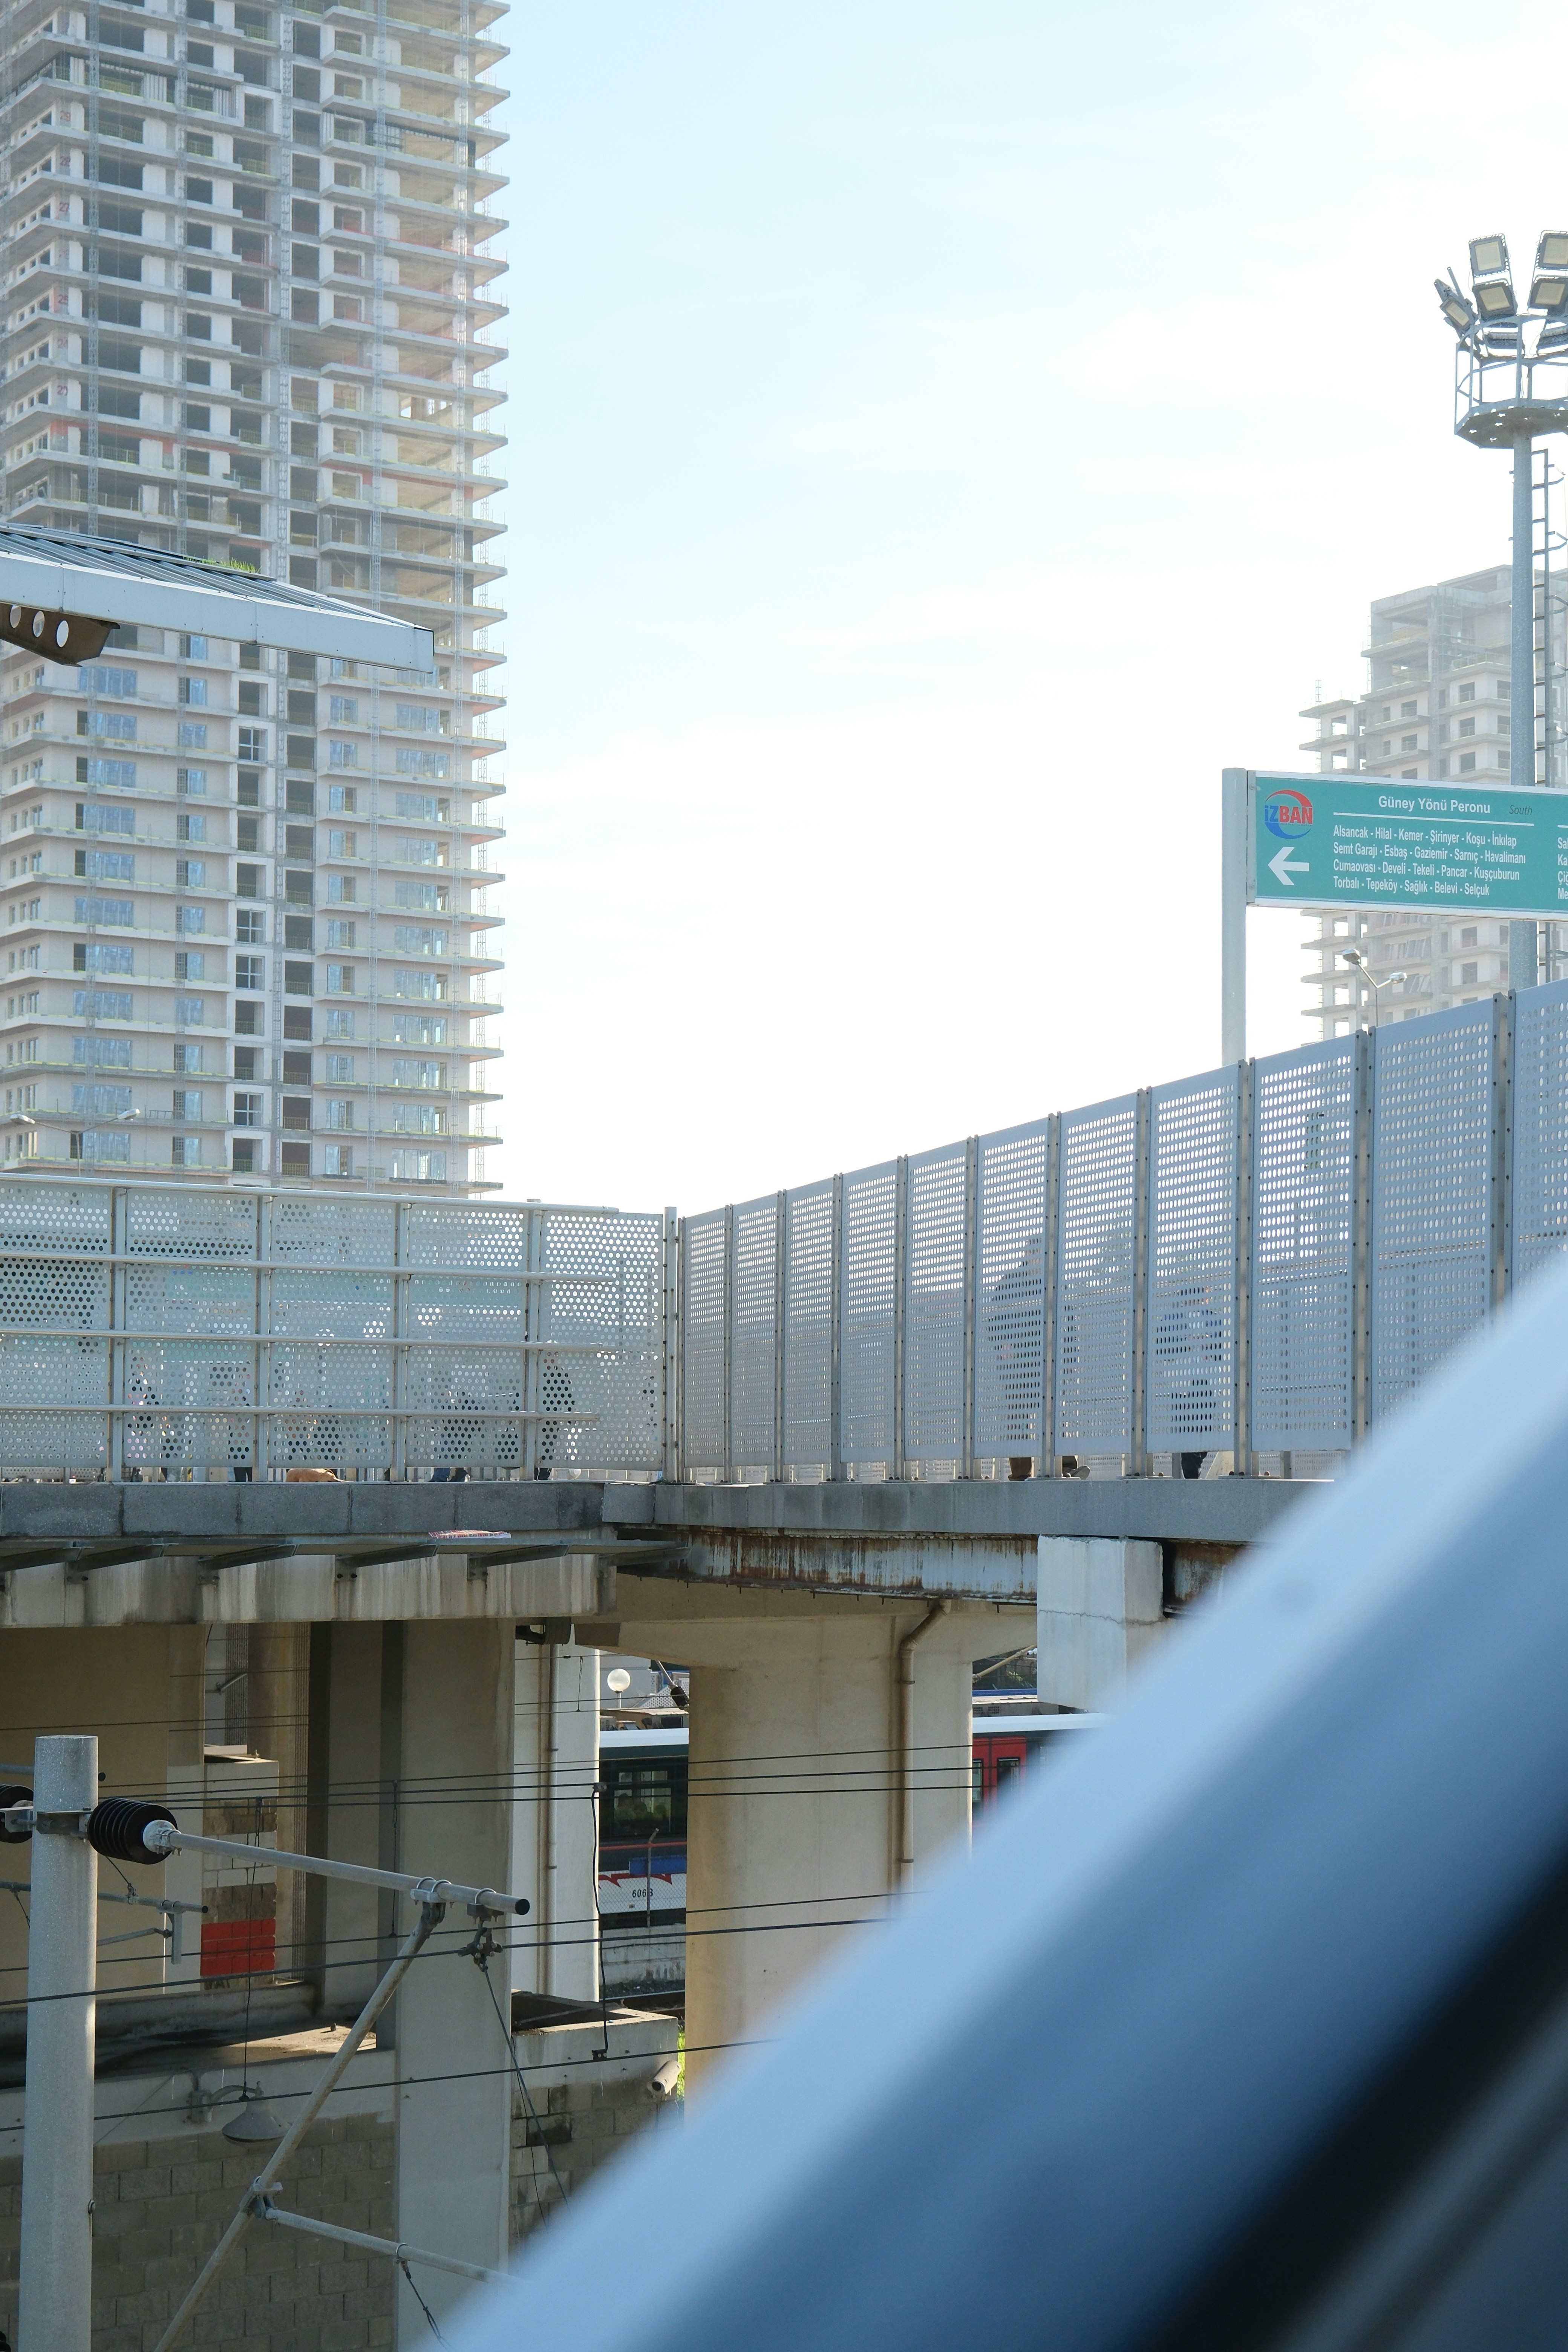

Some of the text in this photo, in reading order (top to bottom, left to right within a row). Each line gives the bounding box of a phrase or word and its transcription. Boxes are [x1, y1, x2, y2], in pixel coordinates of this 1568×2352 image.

[1378, 796, 1490, 813] Güney Yönü Peronu
[1509, 805, 1533, 815] South
[1333, 825, 1368, 838] Alsancak
[1375, 827, 1392, 839] Hilal
[1399, 828, 1423, 841] Kemer
[1430, 830, 1459, 845] Şirinyer
[1466, 832, 1485, 847] Koşu
[1492, 830, 1517, 849] İnkılap
[1334, 842, 1353, 854] Semt
[1355, 843, 1377, 859] Garajı
[1384, 845, 1407, 860] Esbaş
[1415, 846, 1448, 859] Gaziemir
[1455, 848, 1478, 864] Sarnıç
[1485, 850, 1525, 864] Havalimanı
[1334, 859, 1375, 873] Cumaovası
[1383, 862, 1406, 874] Develi
[1413, 863, 1434, 876] Tekeli
[1441, 865, 1467, 877] Pancar
[1474, 867, 1519, 882] Kuşçuburun
[1333, 876, 1359, 889] Torbalı
[1366, 877, 1398, 894] Tepeköy
[1404, 880, 1427, 895] Sağlık
[1435, 881, 1458, 894] Belevi
[1464, 883, 1489, 898] Selçuk
